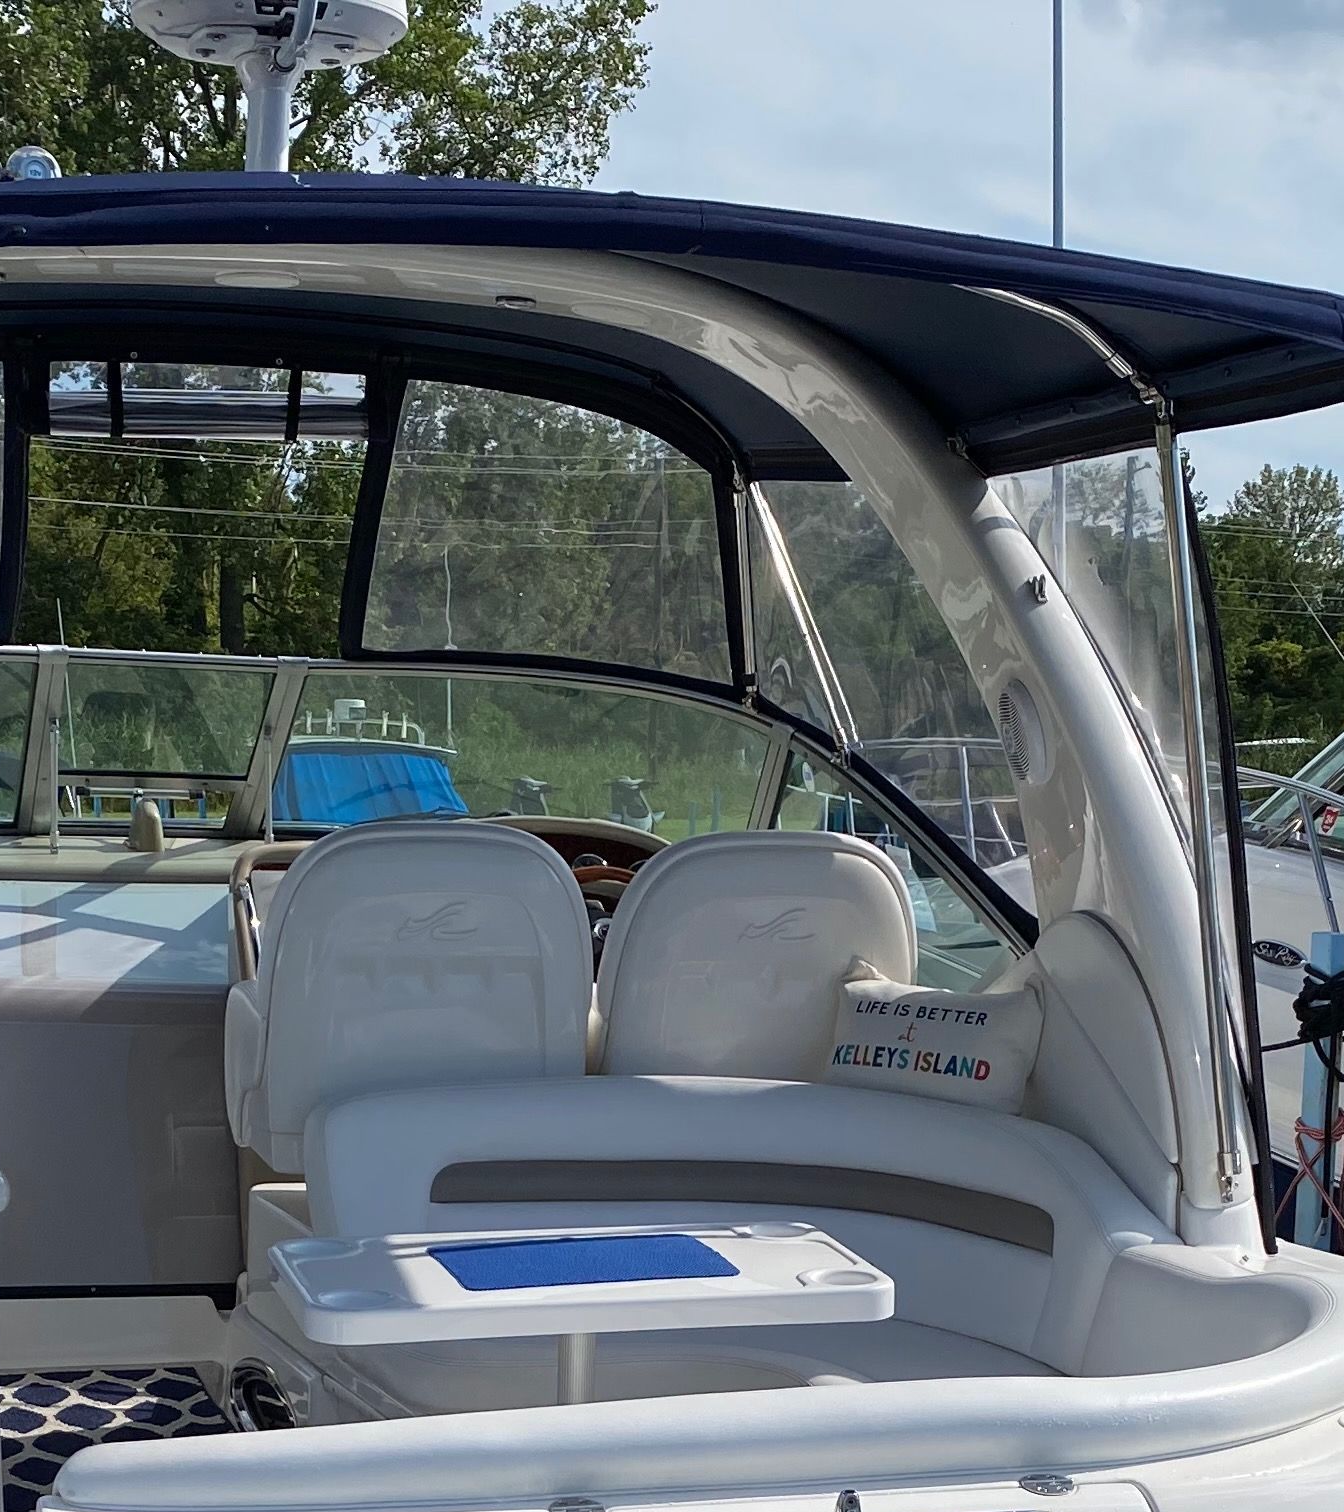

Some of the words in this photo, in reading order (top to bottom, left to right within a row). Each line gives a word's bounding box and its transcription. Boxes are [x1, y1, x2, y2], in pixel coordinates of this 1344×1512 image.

[856, 1000, 891, 1015] LIFE
[893, 1002, 910, 1017] IS
[915, 1005, 989, 1027] BETTER
[898, 1021, 919, 1043] at
[831, 1044, 910, 1071] KELLEYS
[913, 1050, 992, 1081] ISLAND
